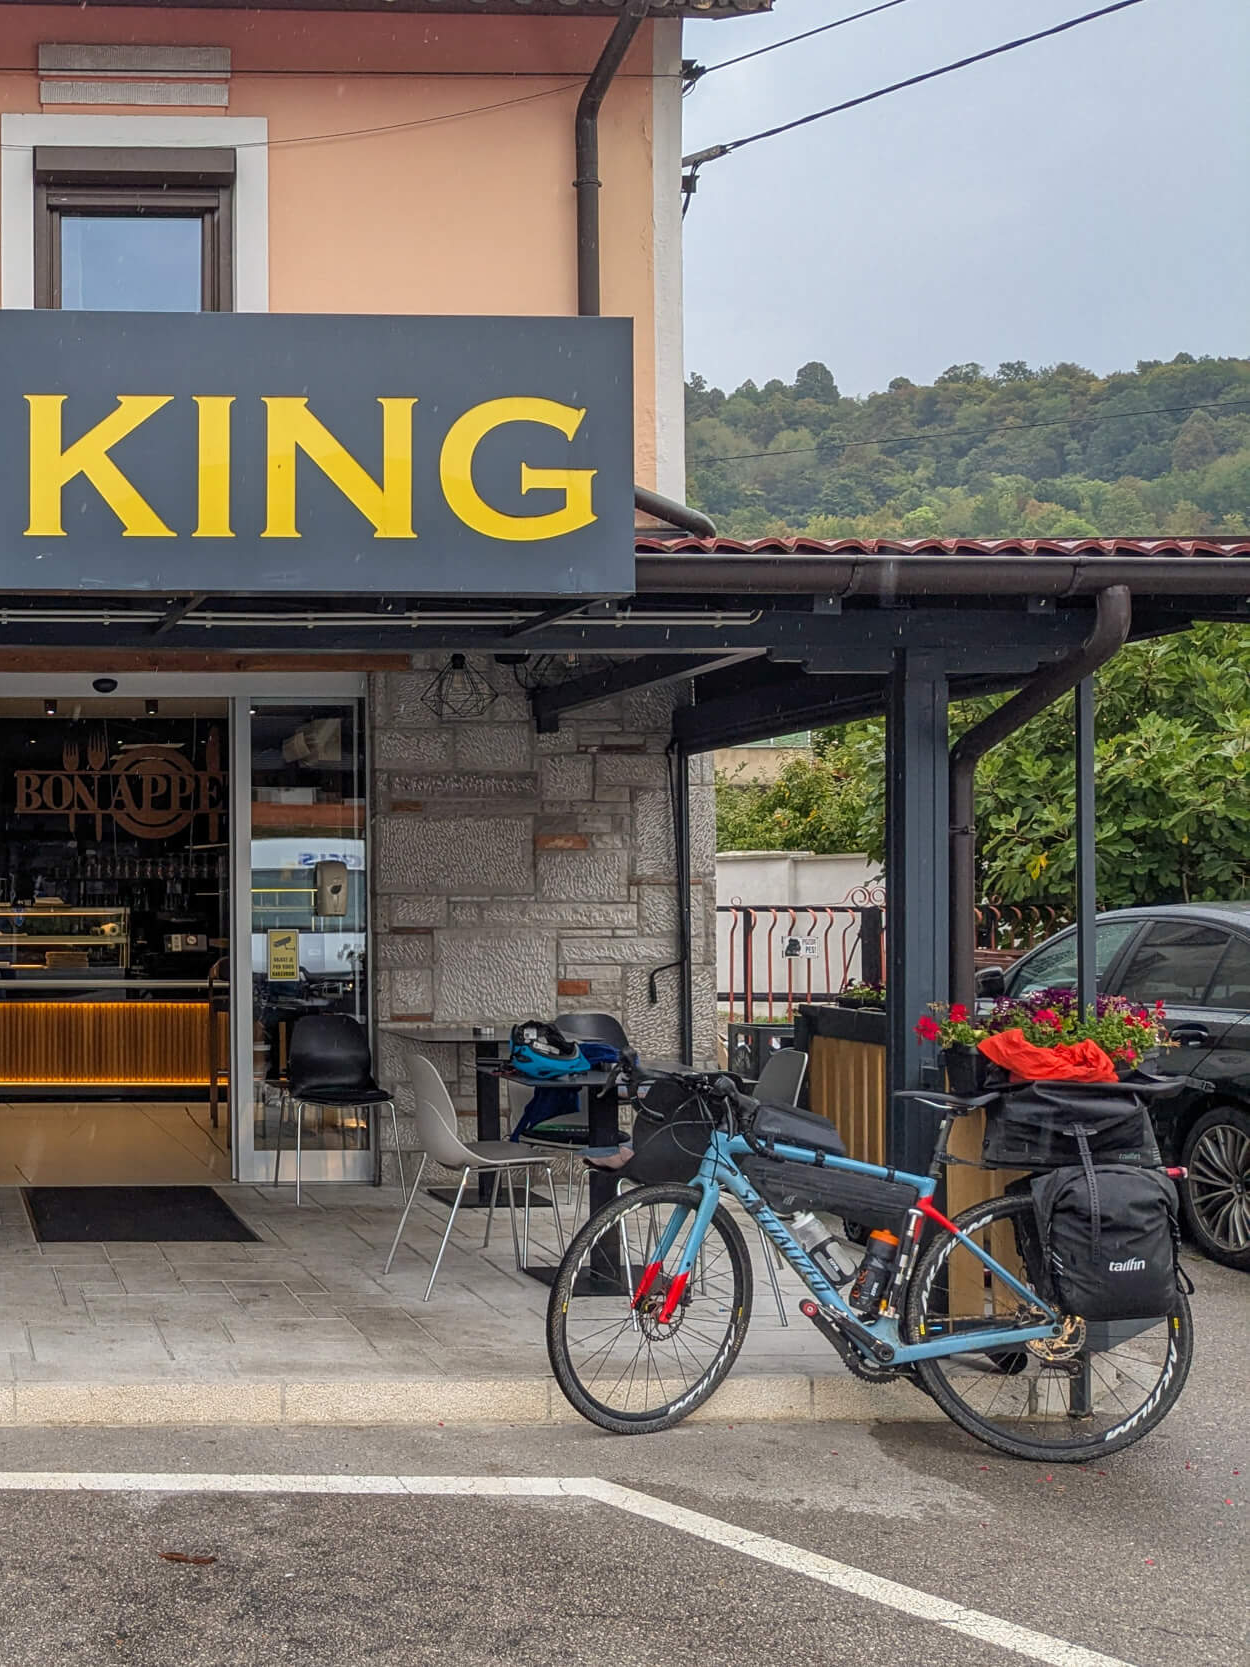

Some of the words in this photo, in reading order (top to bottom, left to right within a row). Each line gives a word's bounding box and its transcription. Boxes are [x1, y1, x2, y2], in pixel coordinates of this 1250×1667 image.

[23, 393, 599, 542] KING
[16, 773, 100, 810] BON
[111, 773, 228, 810] APPE
[1108, 1256, 1146, 1272] tailfin
